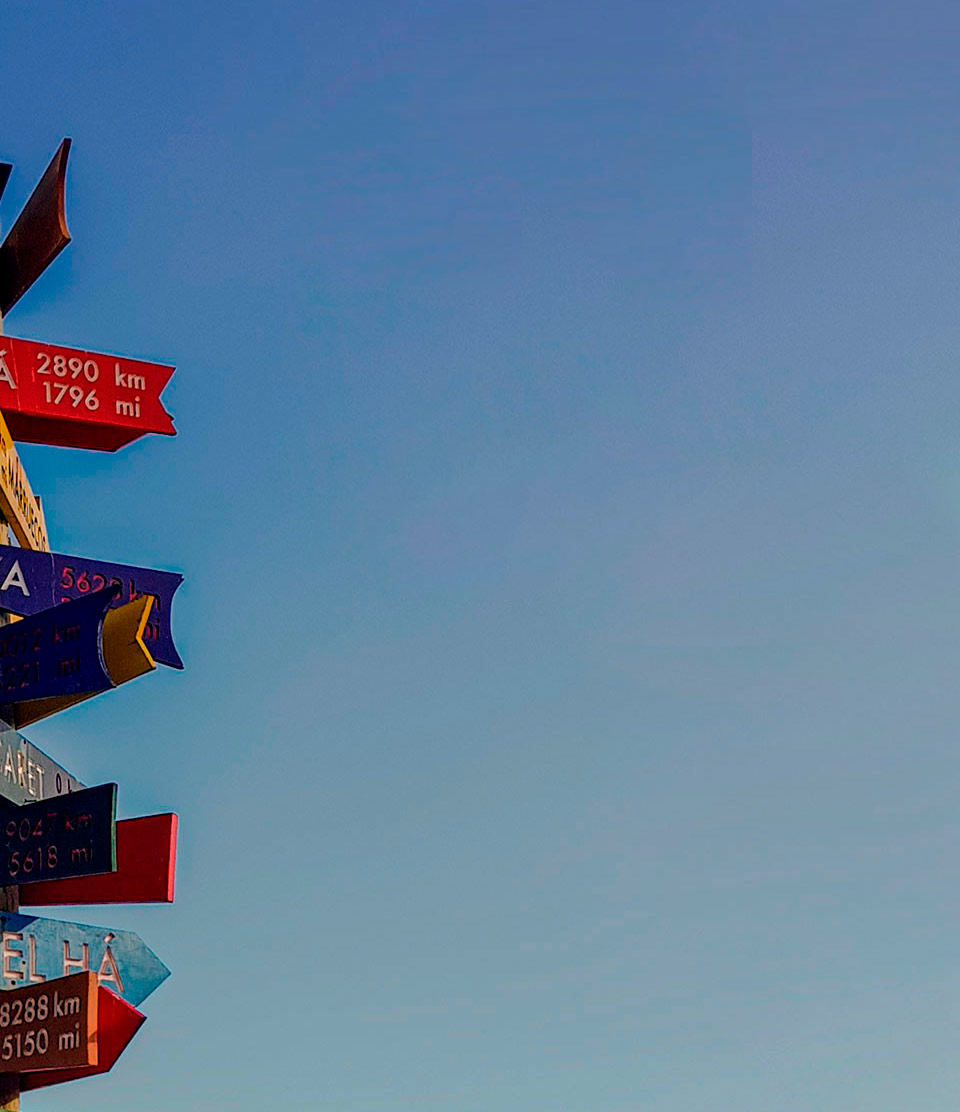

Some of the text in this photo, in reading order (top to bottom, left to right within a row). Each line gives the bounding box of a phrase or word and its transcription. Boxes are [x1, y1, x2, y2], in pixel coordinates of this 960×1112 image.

[36, 352, 146, 390] 2890 km
[42, 381, 141, 418] 1796 mi
[54, 624, 80, 645] km
[60, 648, 80, 674] mi
[5, 809, 93, 841] 9047 km
[8, 838, 93, 877] 5618 mi
[63, 932, 125, 993] HÁ
[0, 992, 80, 1027] 8288 km
[2, 1025, 80, 1060] 5150 mi
